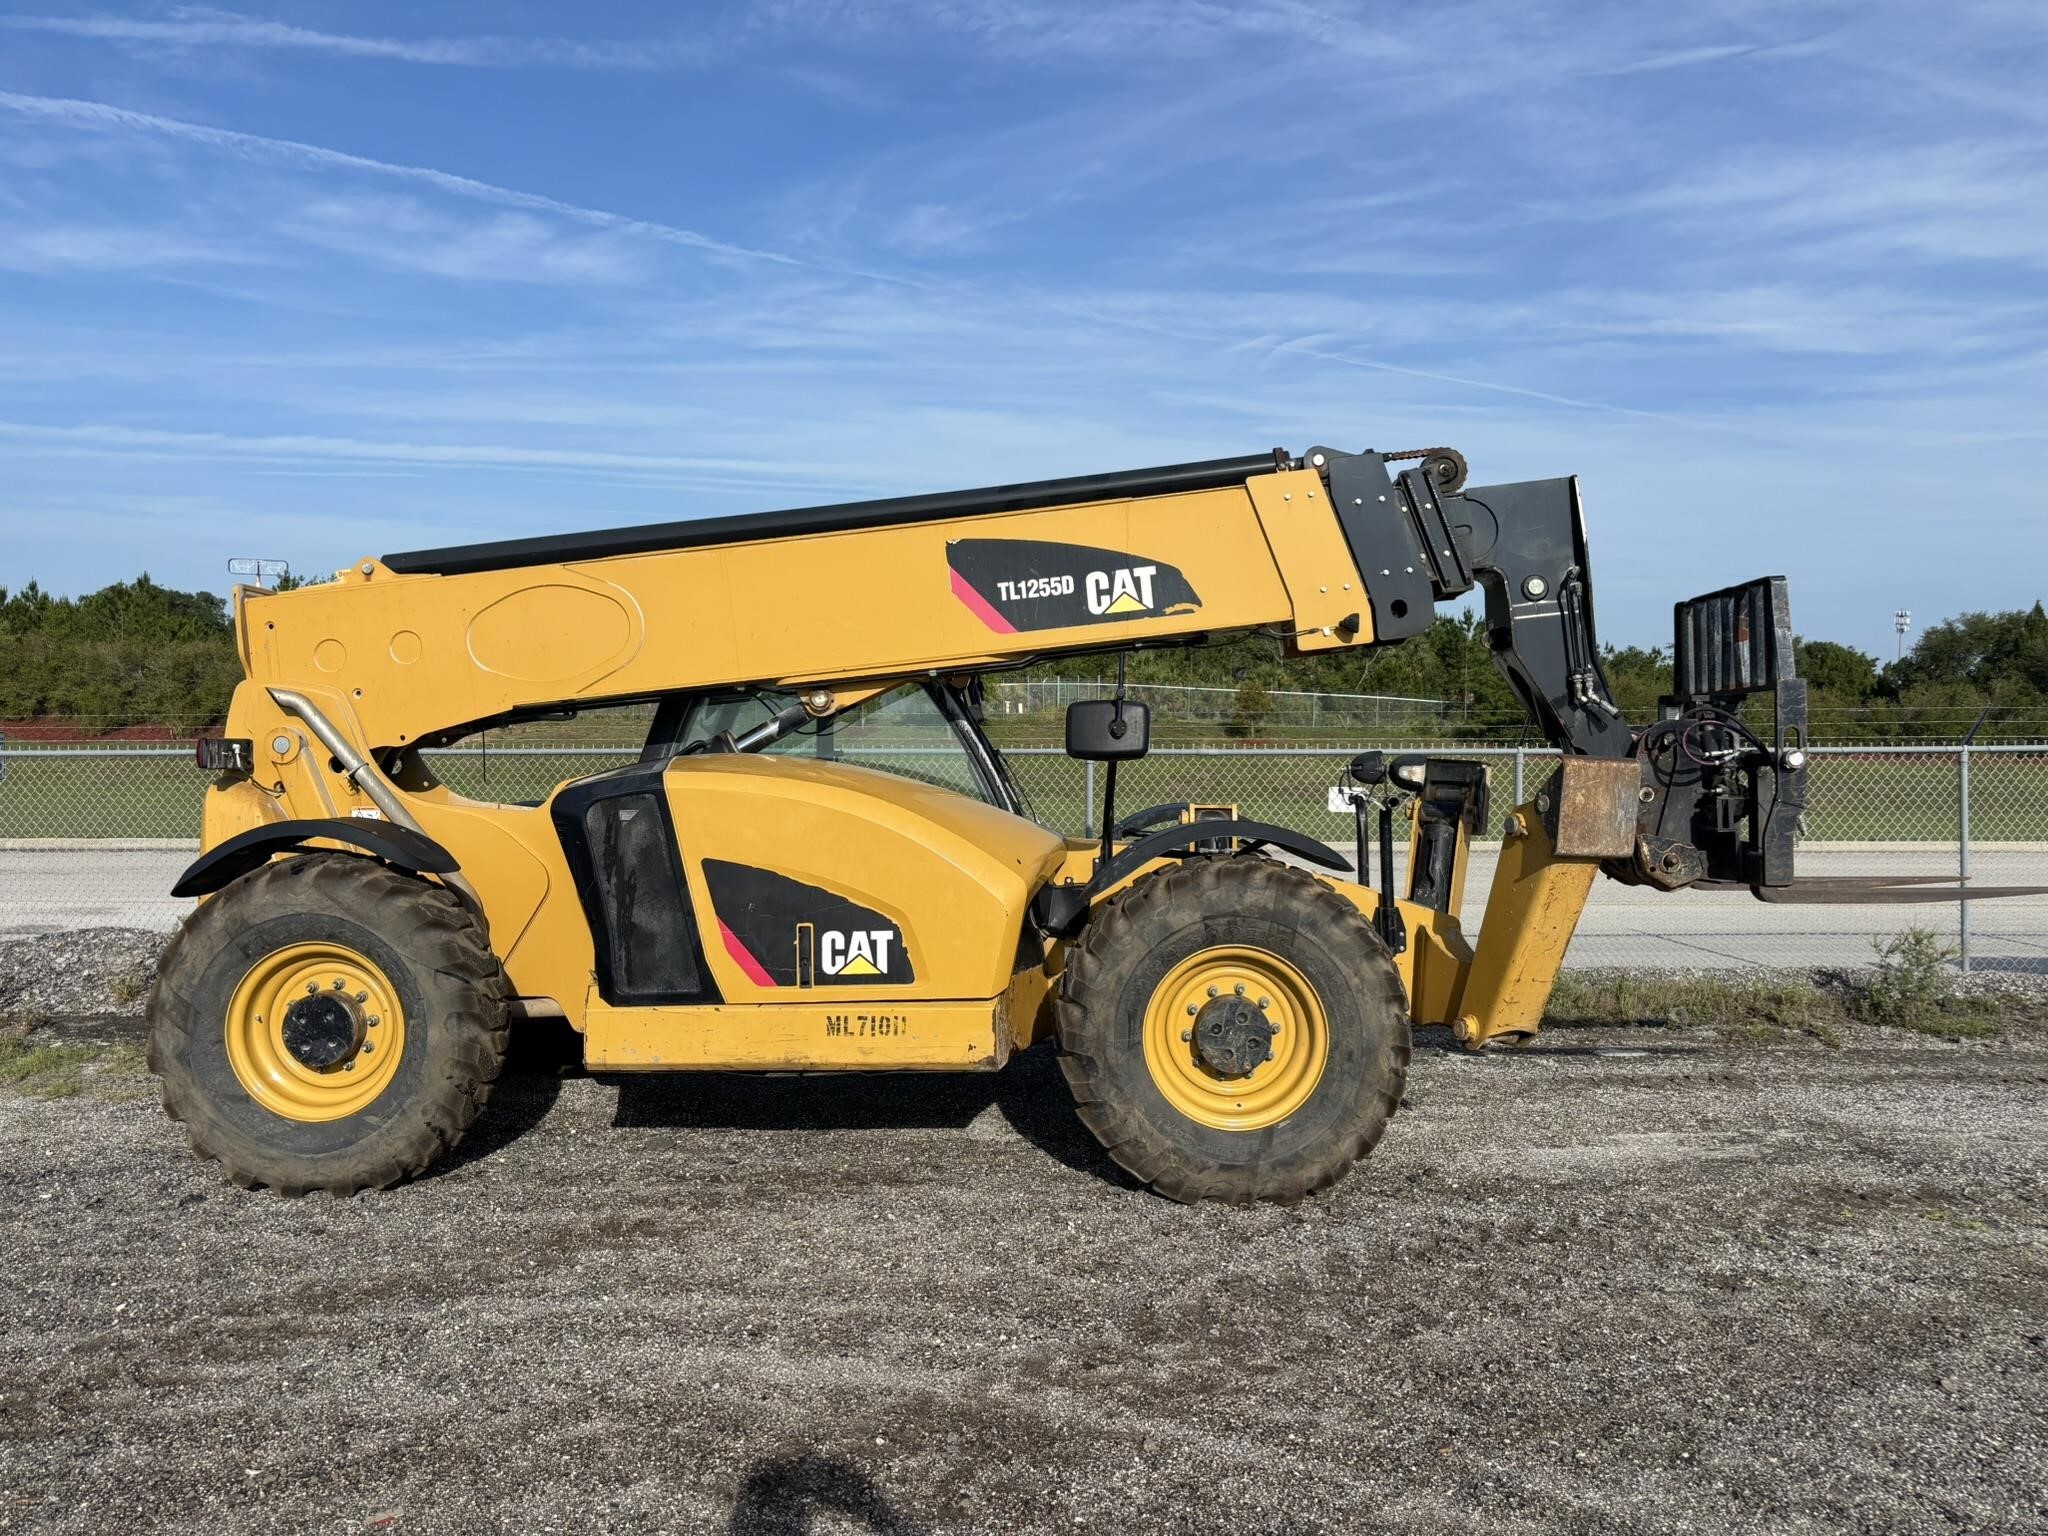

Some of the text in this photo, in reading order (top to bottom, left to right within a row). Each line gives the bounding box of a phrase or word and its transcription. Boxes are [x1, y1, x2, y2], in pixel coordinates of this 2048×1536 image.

[997, 565, 1157, 616] TL1255D CAT
[821, 930, 894, 975] CAT
